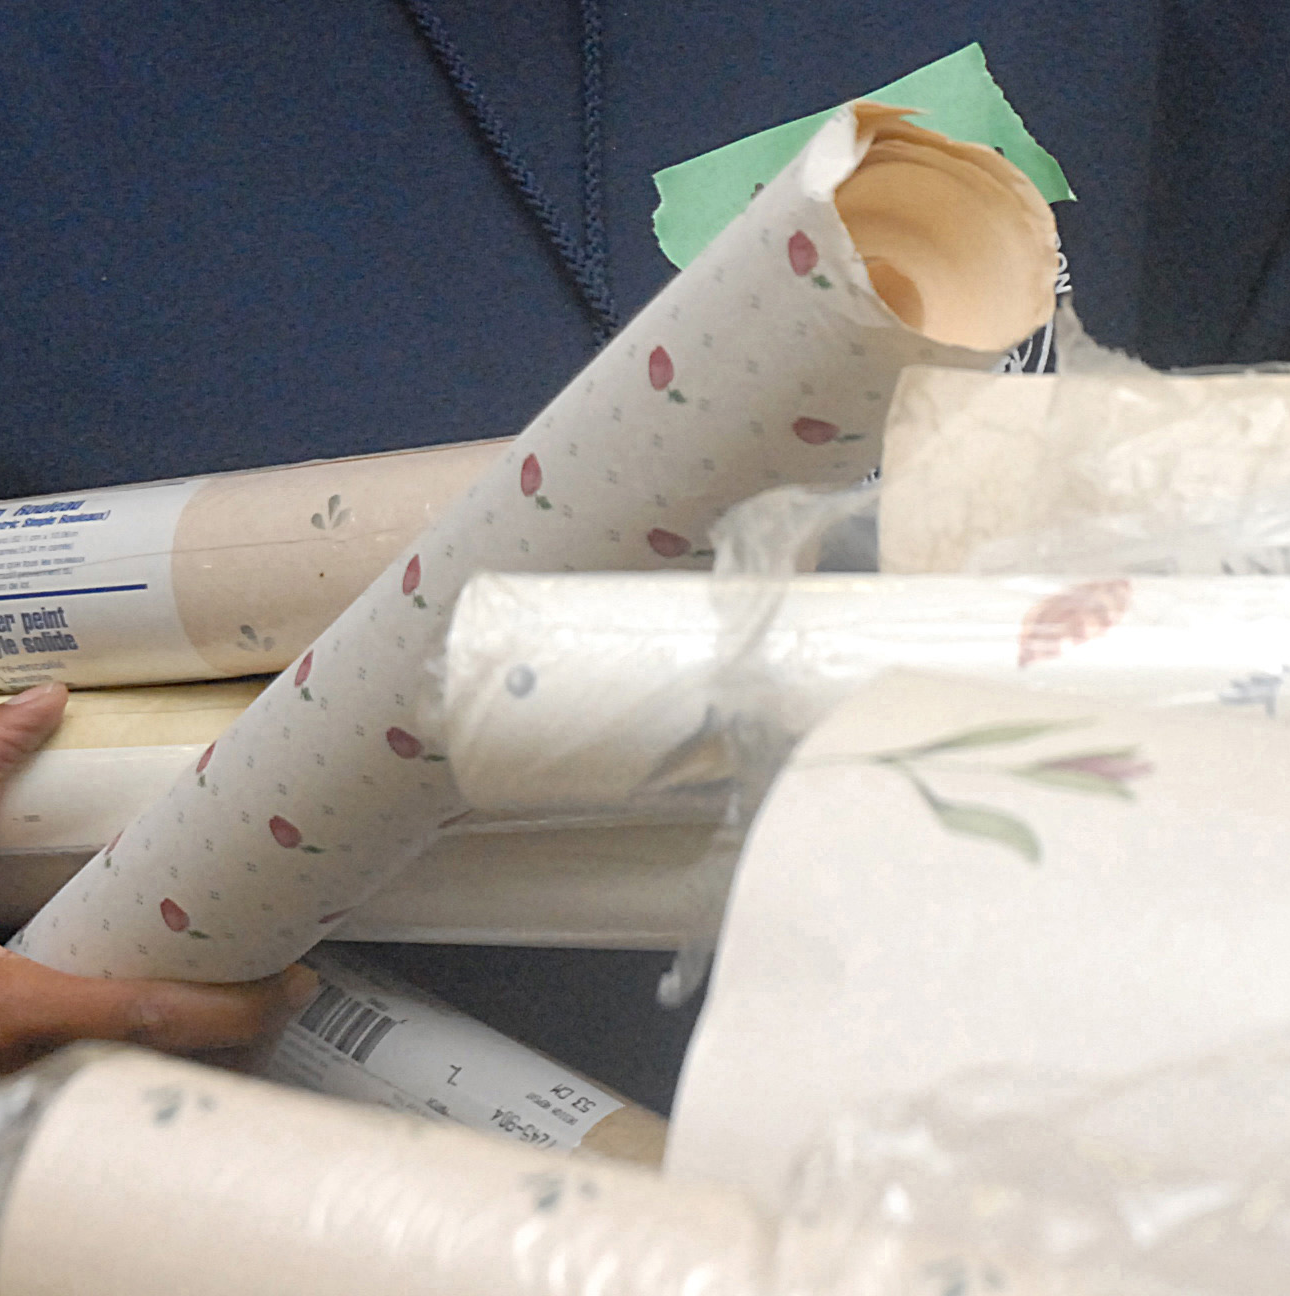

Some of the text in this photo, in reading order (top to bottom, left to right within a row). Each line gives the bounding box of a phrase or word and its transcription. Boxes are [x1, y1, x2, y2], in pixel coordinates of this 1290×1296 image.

[21, 607, 68, 635] peint
[22, 631, 79, 654] solide
[550, 1083, 596, 1113] 53 CM
